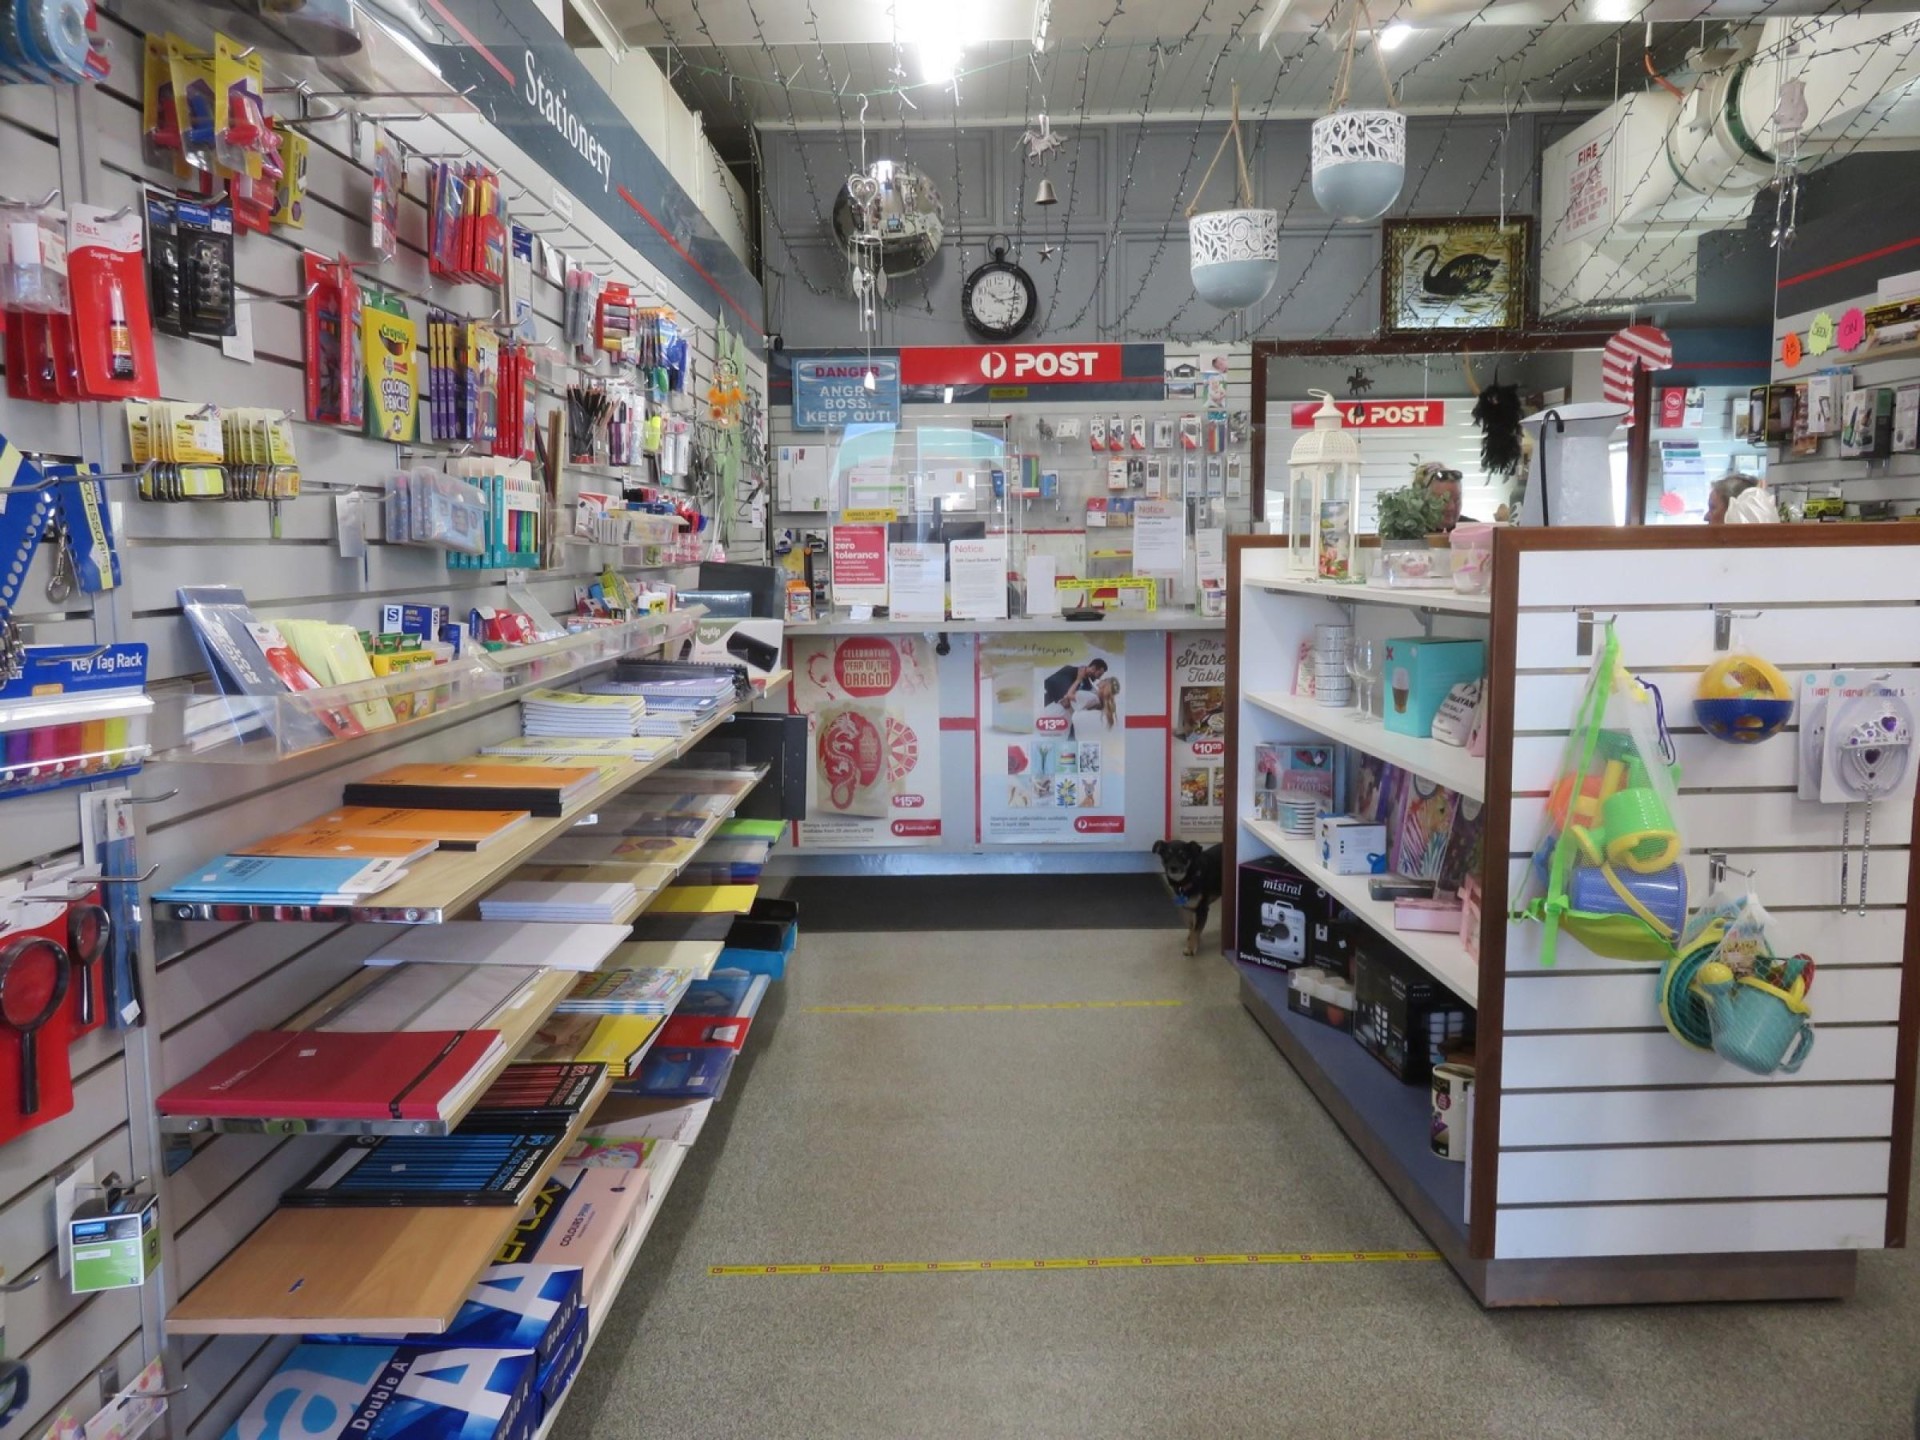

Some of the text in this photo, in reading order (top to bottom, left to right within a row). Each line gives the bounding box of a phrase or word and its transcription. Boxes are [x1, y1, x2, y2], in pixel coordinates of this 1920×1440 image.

[525, 50, 611, 192] Stationery
[1577, 143, 1598, 167] FIRE
[90, 249, 109, 260] Super
[1015, 352, 1098, 376] POST
[815, 367, 880, 378] DANGER
[820, 386, 873, 398] ANGR
[807, 411, 891, 422] KEEP OUT!
[1371, 406, 1429, 424] POST
[1138, 504, 1165, 513] Notice
[835, 542, 856, 550] zero
[955, 545, 984, 554] Notice
[835, 551, 880, 560] tolerance
[71, 652, 143, 675] Key Tag Rack
[844, 660, 890, 672] YEAR OF THE
[1177, 650, 1226, 669] Share
[844, 672, 891, 687] DRAGON
[1188, 668, 1225, 682] Table
[1811, 688, 1829, 697] Tiar
[1263, 879, 1303, 896] mistral
[1239, 952, 1287, 970] Sewing Machine
[560, 1214, 585, 1247] COLOURS
[350, 1373, 401, 1432] Double
